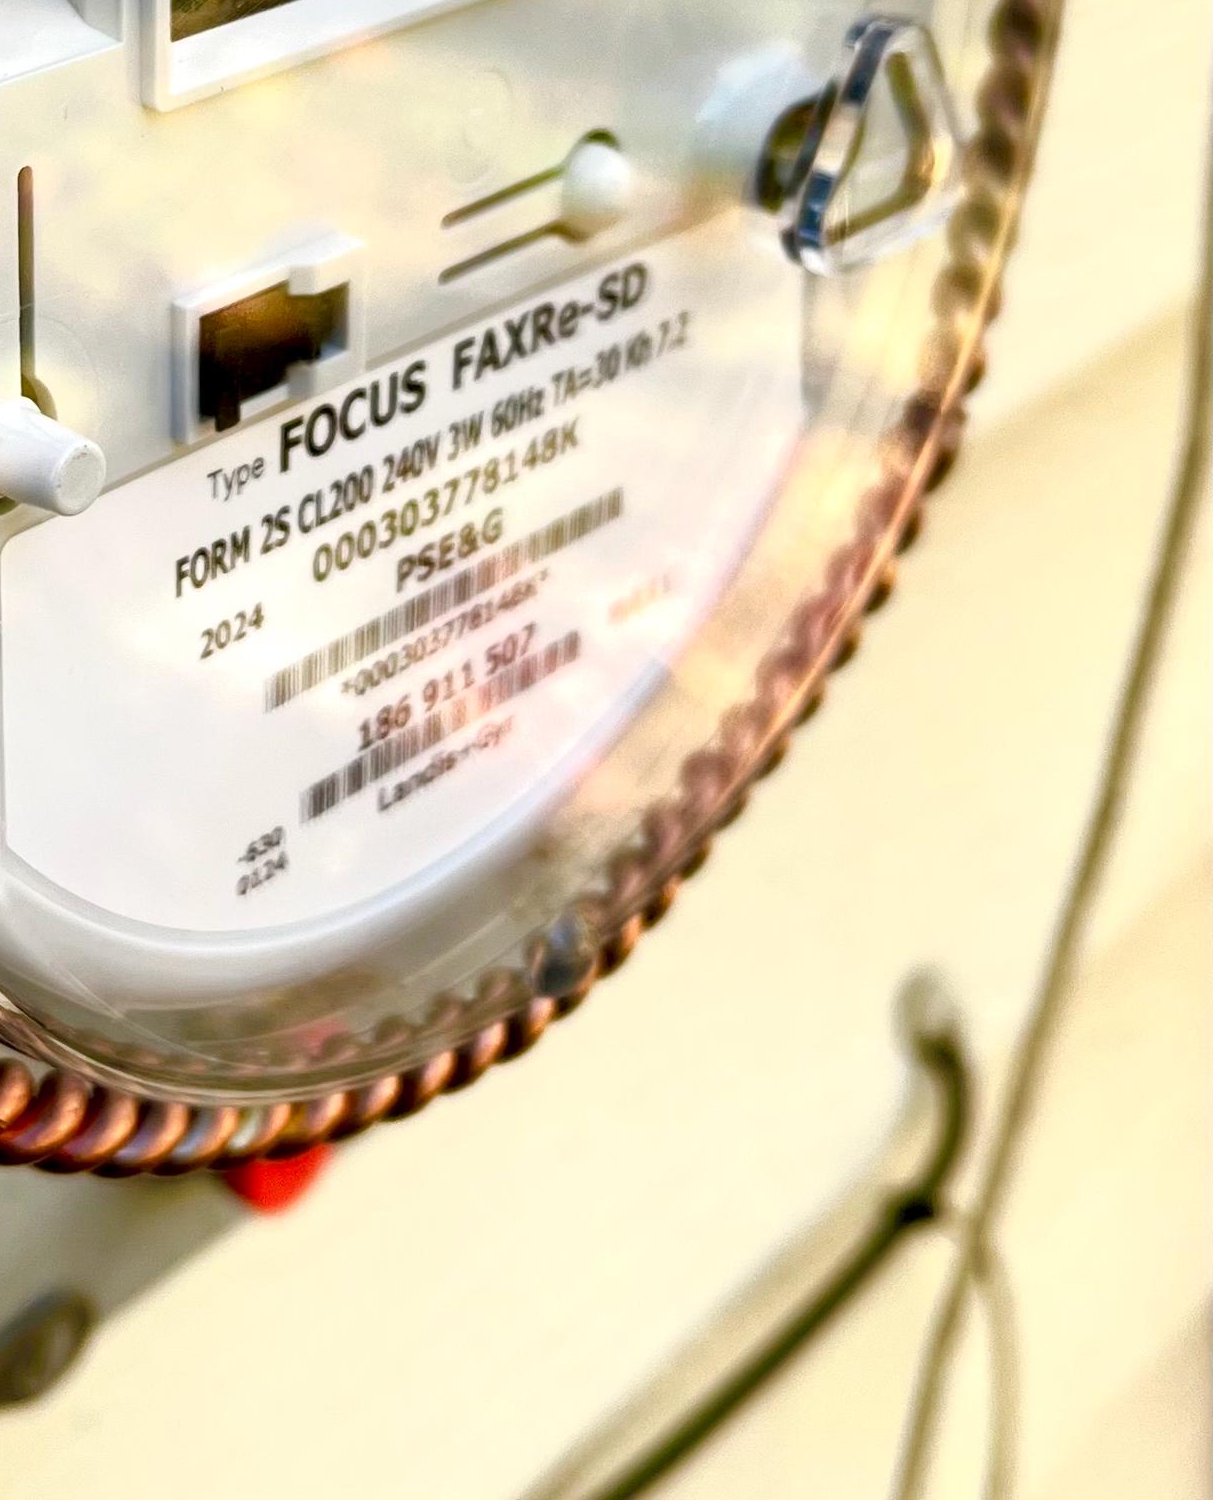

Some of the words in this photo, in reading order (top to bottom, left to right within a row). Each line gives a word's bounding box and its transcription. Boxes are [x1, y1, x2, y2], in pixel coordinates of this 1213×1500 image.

[206, 456, 266, 502] Type
[279, 360, 428, 474] FOCUS
[452, 262, 650, 392] FAXRe-SD
[175, 525, 251, 599] FORM
[259, 505, 292, 556] 2S
[297, 463, 375, 535] CL200
[381, 429, 442, 494] 240V
[447, 410, 486, 462] 3W
[490, 385, 546, 439] 60Hz
[550, 343, 622, 407] TA=30
[312, 416, 581, 584] 000303778148K
[395, 506, 505, 594] PSE&G
[198, 601, 266, 661] 2024
[358, 692, 412, 751] 186
[422, 659, 476, 713] 911
[485, 620, 538, 677] 507
